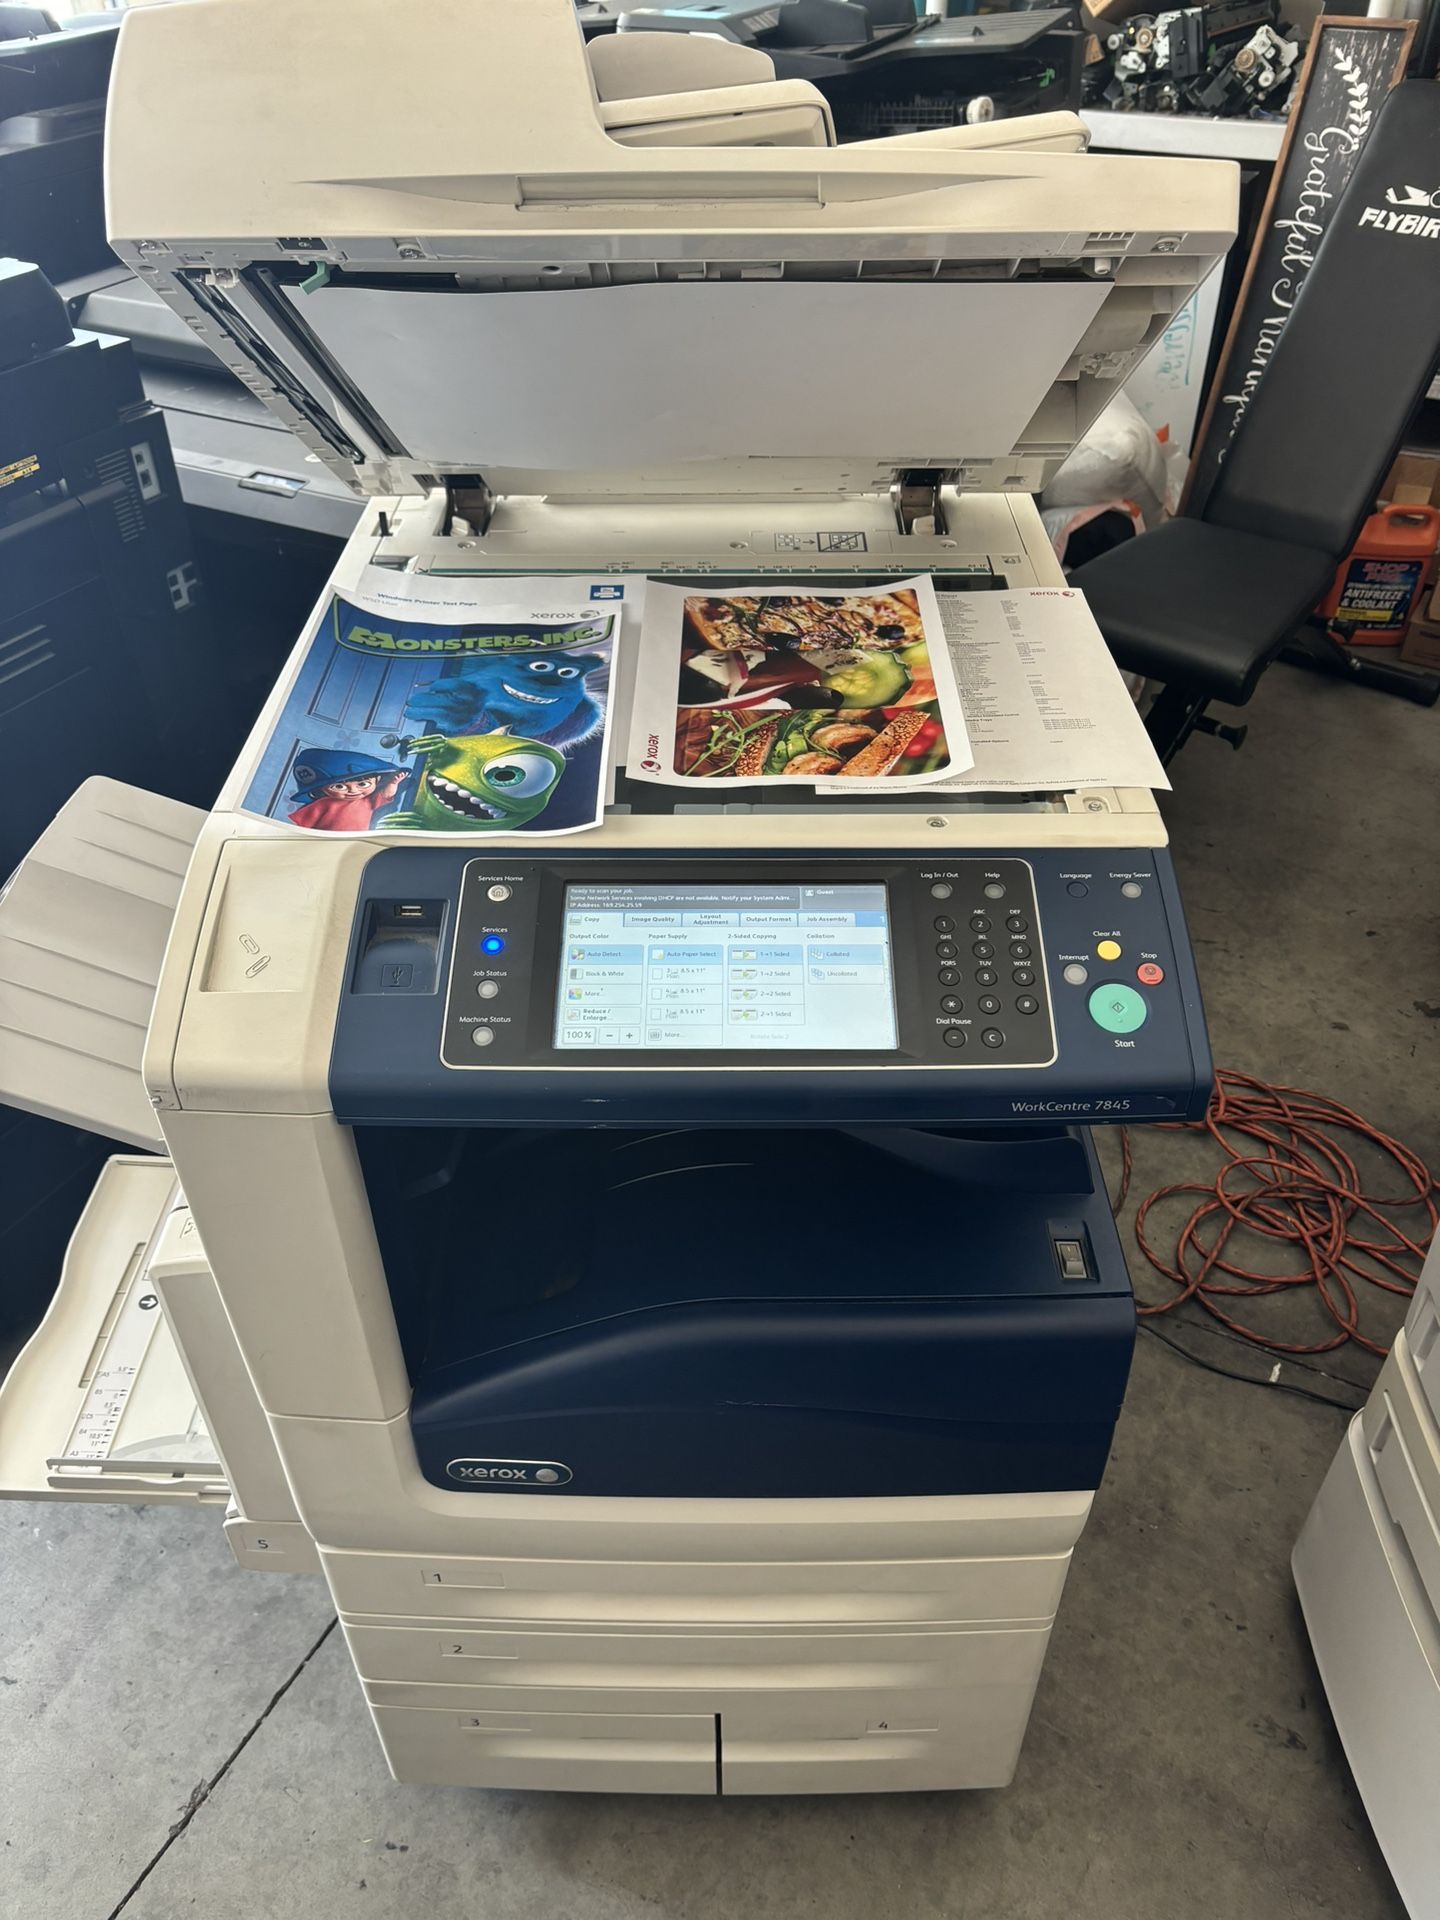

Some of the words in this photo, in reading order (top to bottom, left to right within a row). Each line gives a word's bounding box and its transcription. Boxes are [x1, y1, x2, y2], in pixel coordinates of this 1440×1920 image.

[1344, 588, 1404, 600] ANTIFREEZE
[1340, 598, 1350, 607] &
[1351, 599, 1398, 609] COOLANT
[530, 610, 575, 620] xerox
[542, 627, 602, 645] INC.
[647, 733, 660, 759] xerox
[652, 916, 675, 924] Quality
[989, 1034, 996, 1042] C
[1114, 1040, 1136, 1048] Start
[1011, 1100, 1091, 1112] WorkCentre
[1095, 1099, 1131, 1111] 7845
[460, 1467, 527, 1480] xerox
[257, 1539, 269, 1550] 5
[433, 1573, 442, 1583] 1
[452, 1645, 463, 1654] 2
[470, 1718, 480, 1727] 3
[878, 1721, 888, 1730] 4
